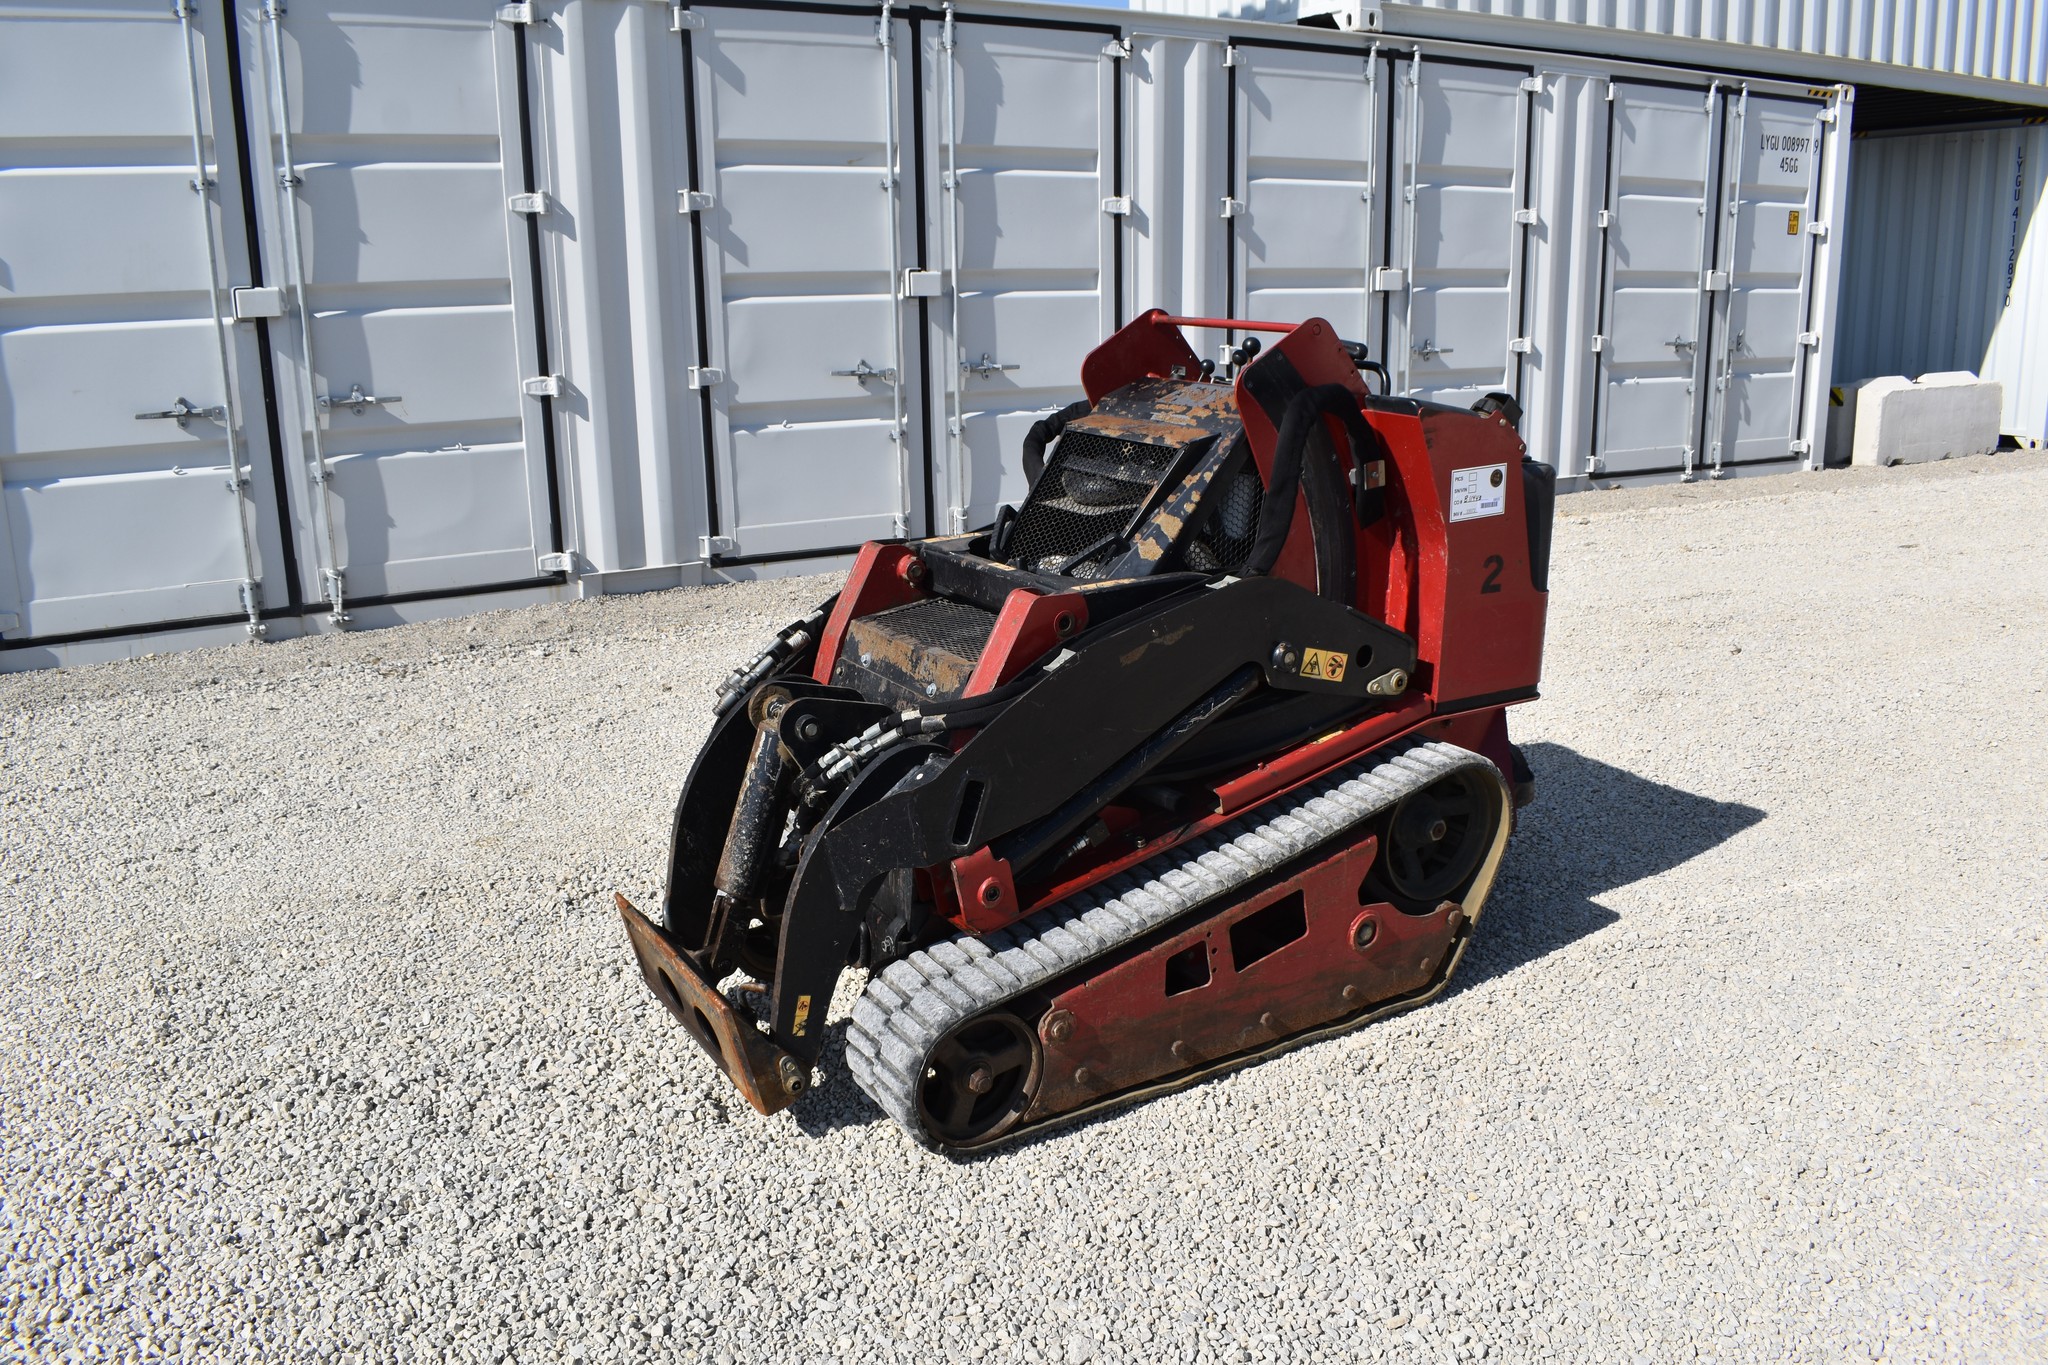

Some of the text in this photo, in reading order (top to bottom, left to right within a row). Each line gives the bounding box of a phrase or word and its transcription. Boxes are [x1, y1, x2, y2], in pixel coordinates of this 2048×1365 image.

[1760, 134, 1820, 154] LYGU 008997 9
[2014, 146, 2023, 201] LYGU
[2006, 206, 2019, 290] 411283
[1480, 554, 1504, 595] 2
